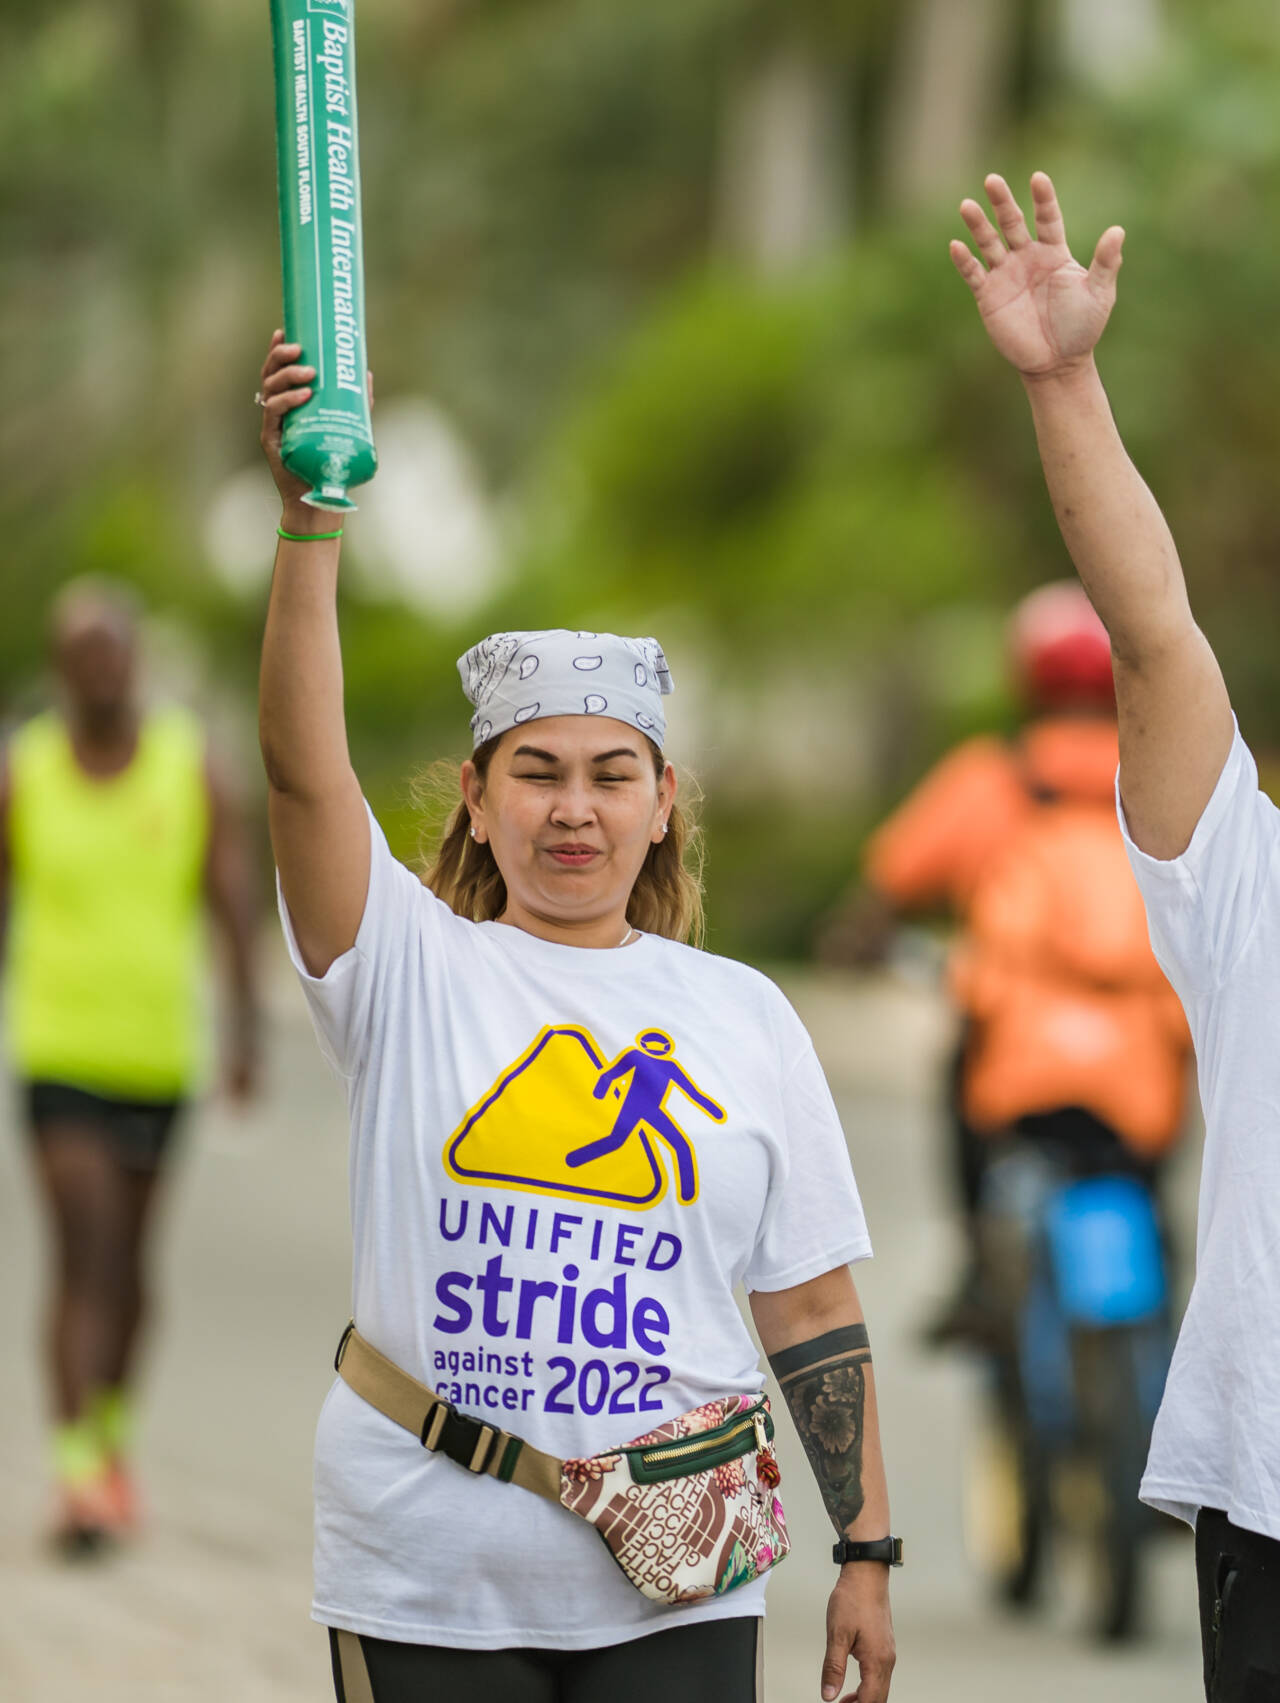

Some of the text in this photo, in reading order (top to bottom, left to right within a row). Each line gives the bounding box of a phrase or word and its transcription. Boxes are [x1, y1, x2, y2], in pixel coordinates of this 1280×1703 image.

[316, 18, 349, 117] Baptist
[292, 19, 312, 225] BAPTIST HEALTH SOUTH FLORIDA
[326, 119, 354, 211] Health
[330, 215, 362, 395] International
[438, 1198, 683, 1272] UNIFIED
[432, 1254, 670, 1357] stride
[433, 1345, 534, 1378] against
[435, 1355, 671, 1415] cancer 2022
[625, 1484, 688, 1537] GUCCI
[641, 1517, 701, 1567] GUCCI
[630, 1533, 681, 1576] FACE
